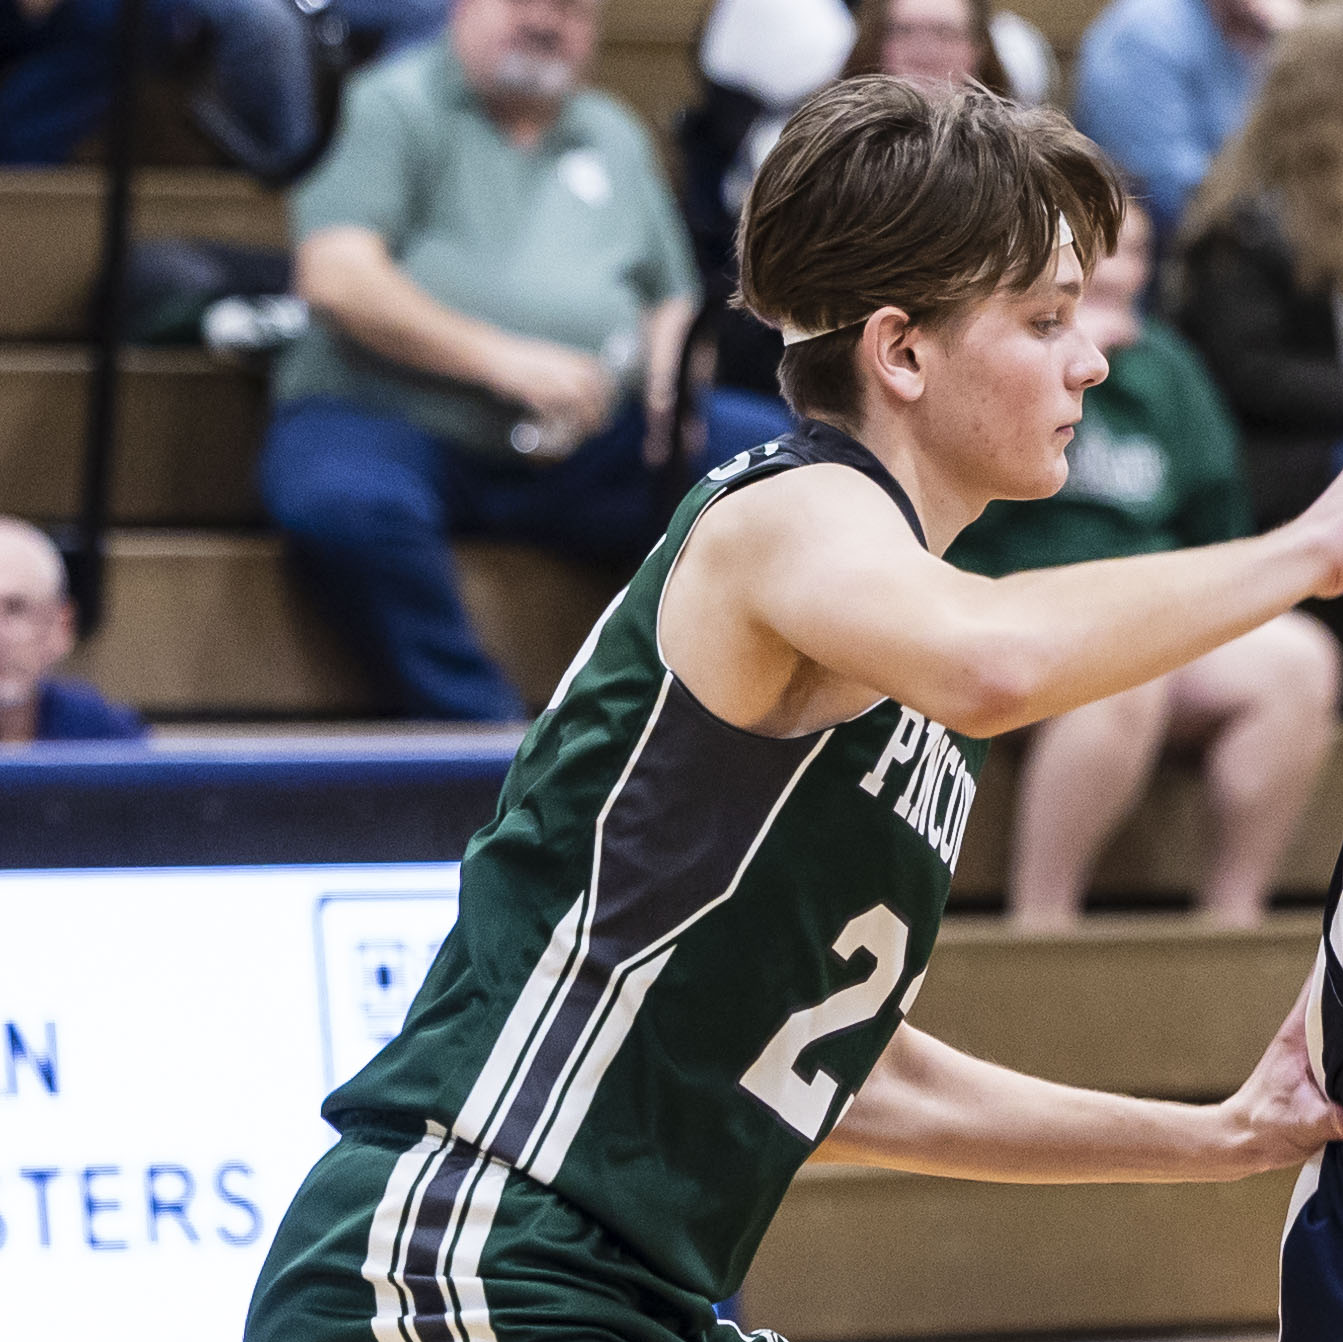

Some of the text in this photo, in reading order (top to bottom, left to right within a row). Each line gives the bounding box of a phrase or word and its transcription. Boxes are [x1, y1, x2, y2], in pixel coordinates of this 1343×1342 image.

[859, 704, 977, 876] PINCO
[739, 903, 928, 1142] 2
[0, 1161, 265, 1251] TERS
